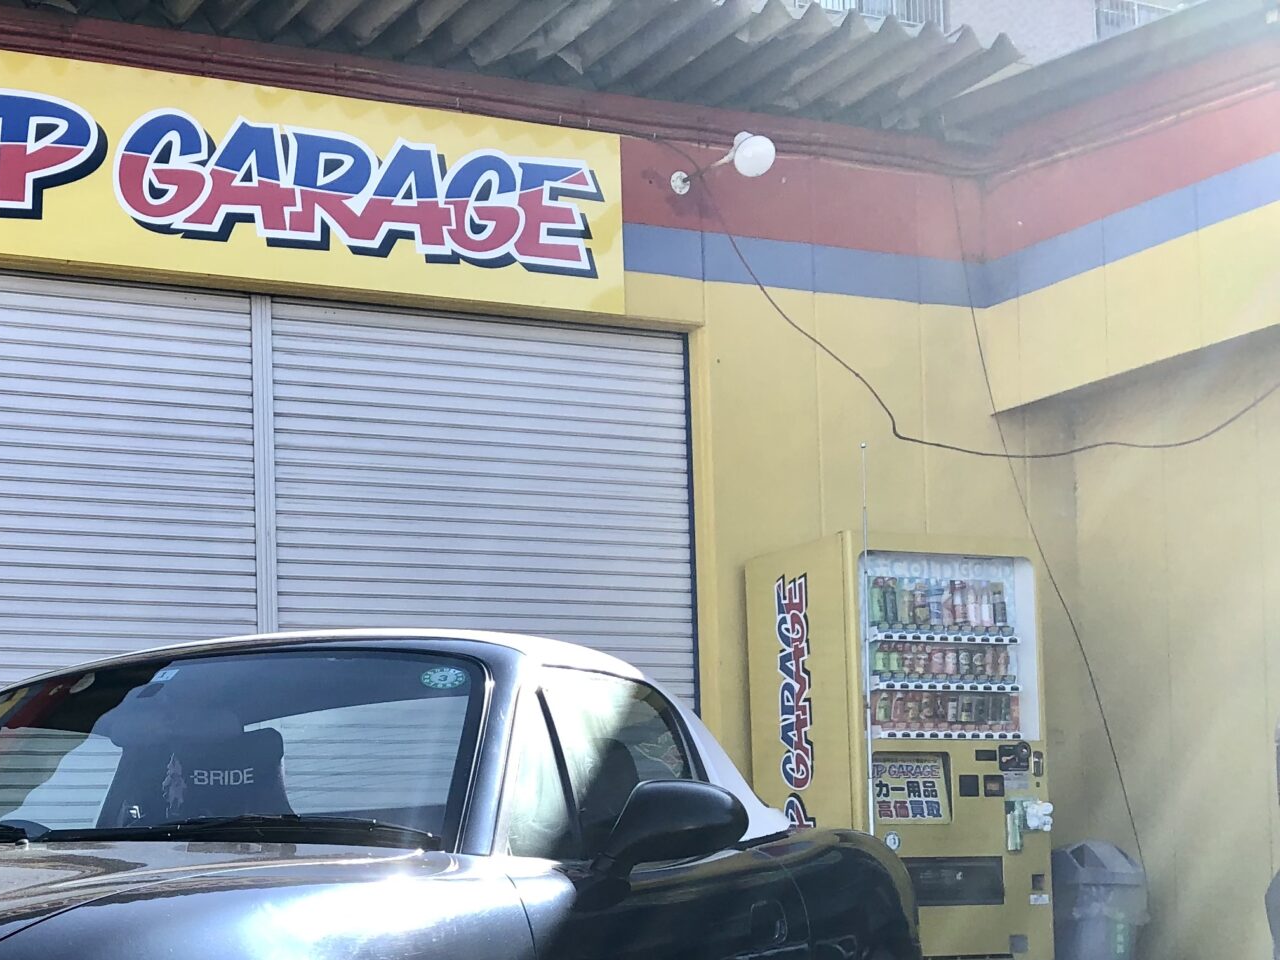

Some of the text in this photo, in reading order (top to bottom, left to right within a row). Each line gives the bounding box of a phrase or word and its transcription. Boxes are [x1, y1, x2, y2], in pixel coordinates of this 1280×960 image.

[114, 107, 606, 279] GARAGE
[774, 573, 814, 791] GARAGE
[190, 767, 255, 786] BRIDE
[888, 763, 941, 778] GARAGE
[875, 780, 938, 798] カー用品
[877, 800, 942, 818] 高価買取
